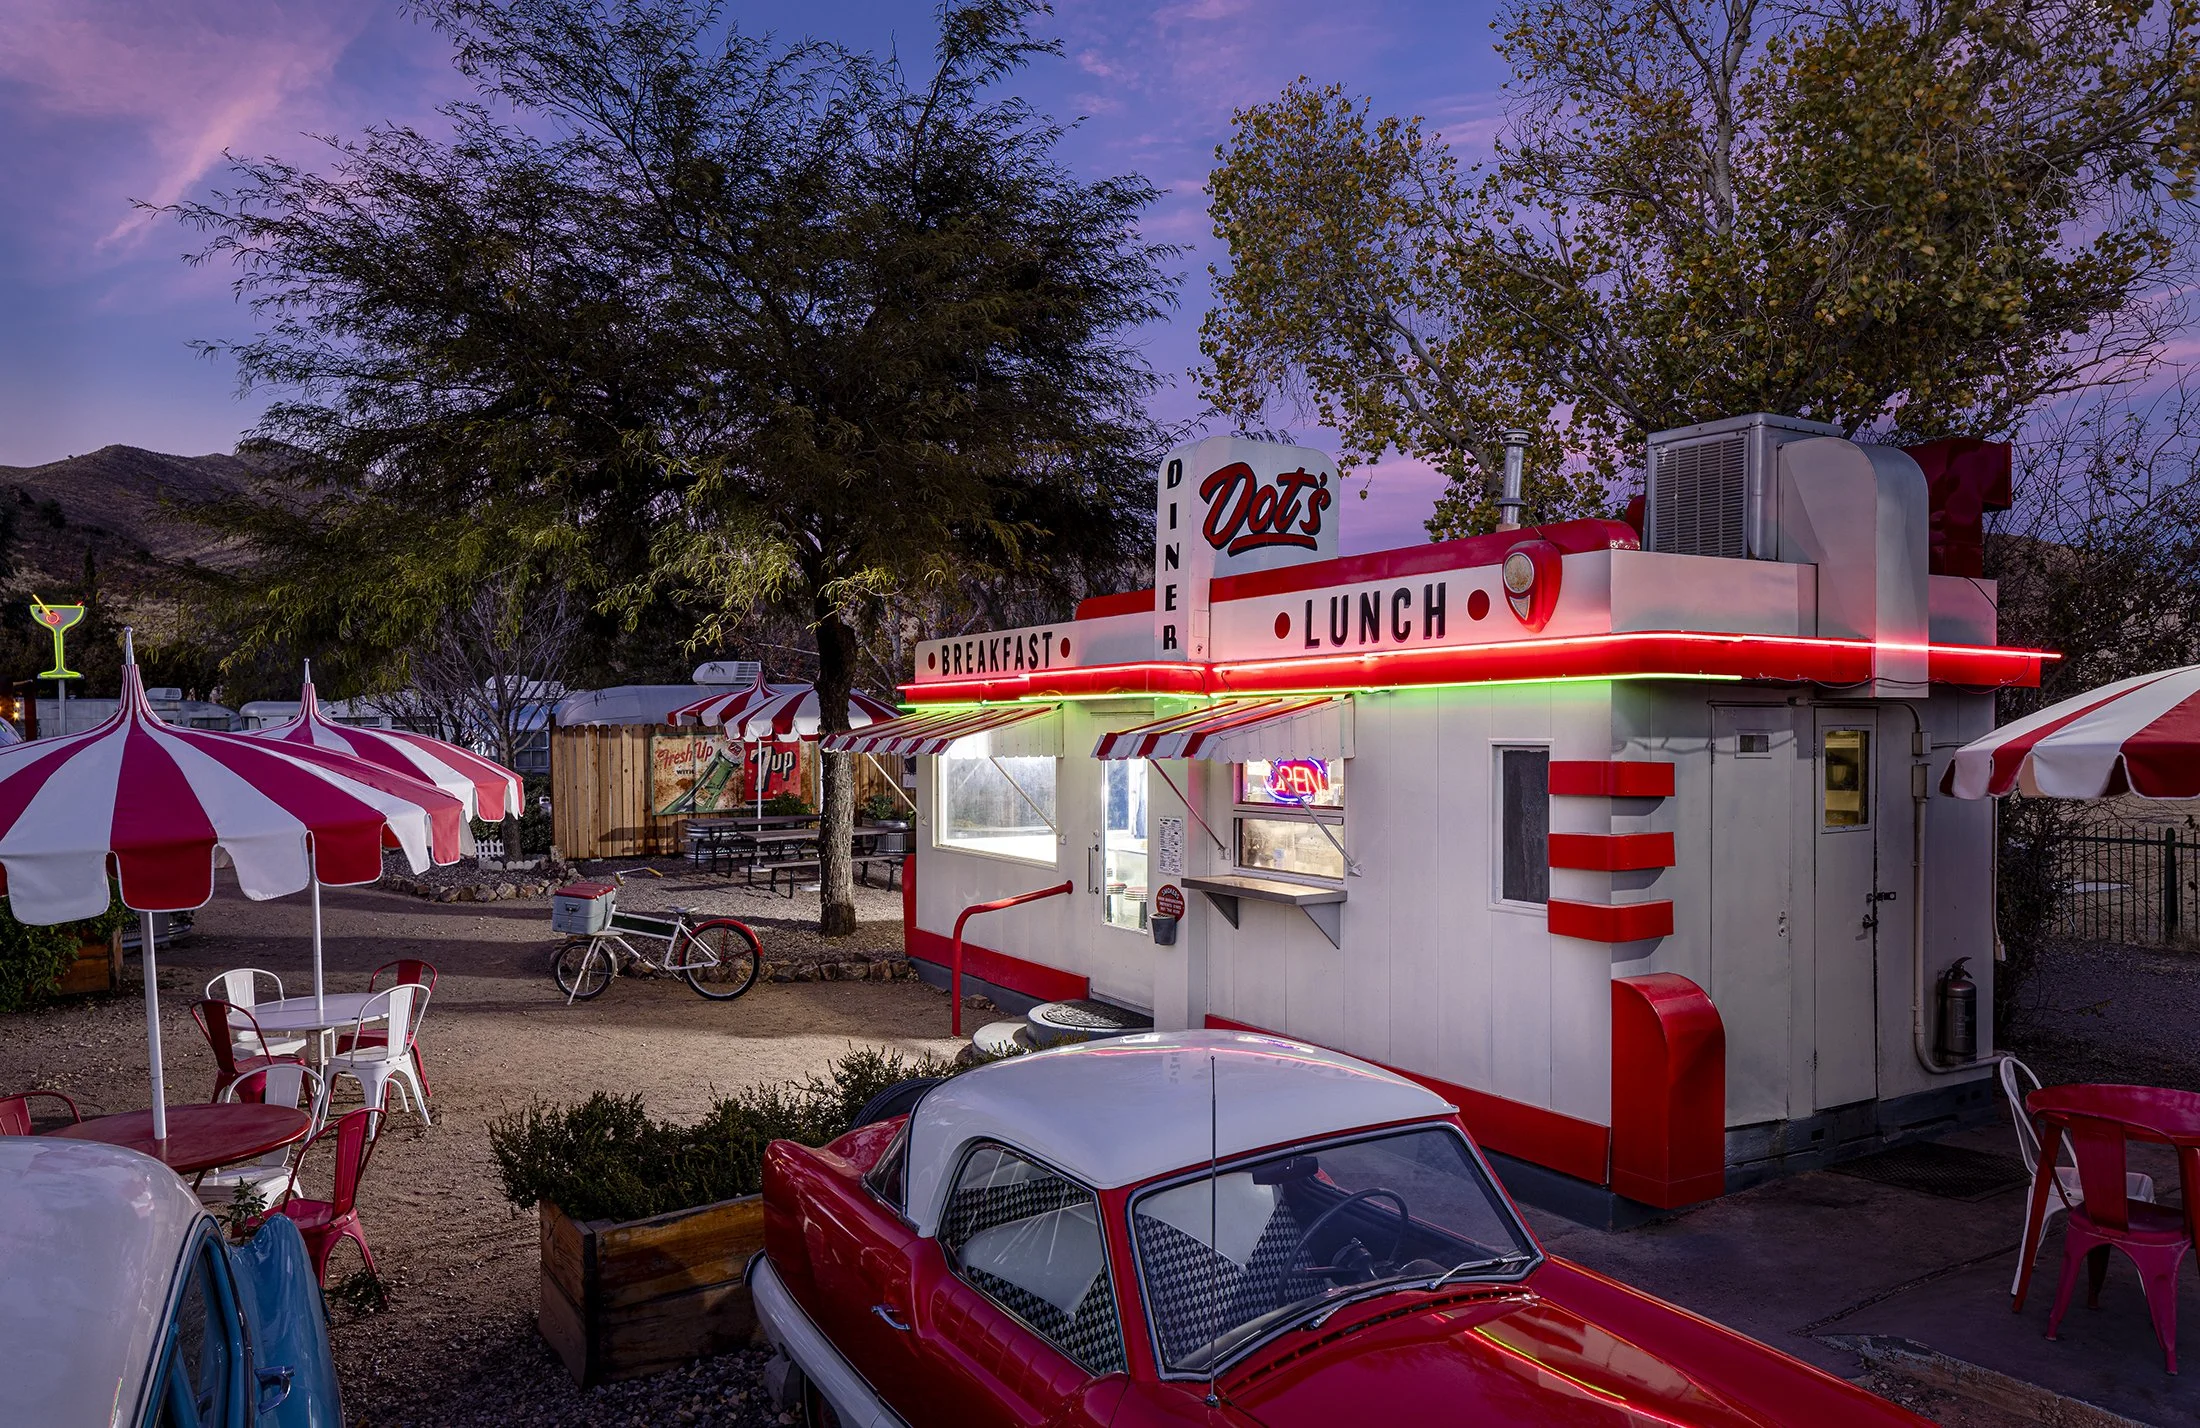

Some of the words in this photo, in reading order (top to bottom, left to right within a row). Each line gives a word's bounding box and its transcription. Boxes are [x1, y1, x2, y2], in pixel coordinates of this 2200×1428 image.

[1199, 461, 1331, 551] Dot's
[1163, 458, 1183, 651] DINER
[1305, 582, 1447, 650] LUNCH
[941, 631, 1053, 677] BREAKFAST
[657, 744, 693, 769] Fresh
[694, 741, 714, 762] Up
